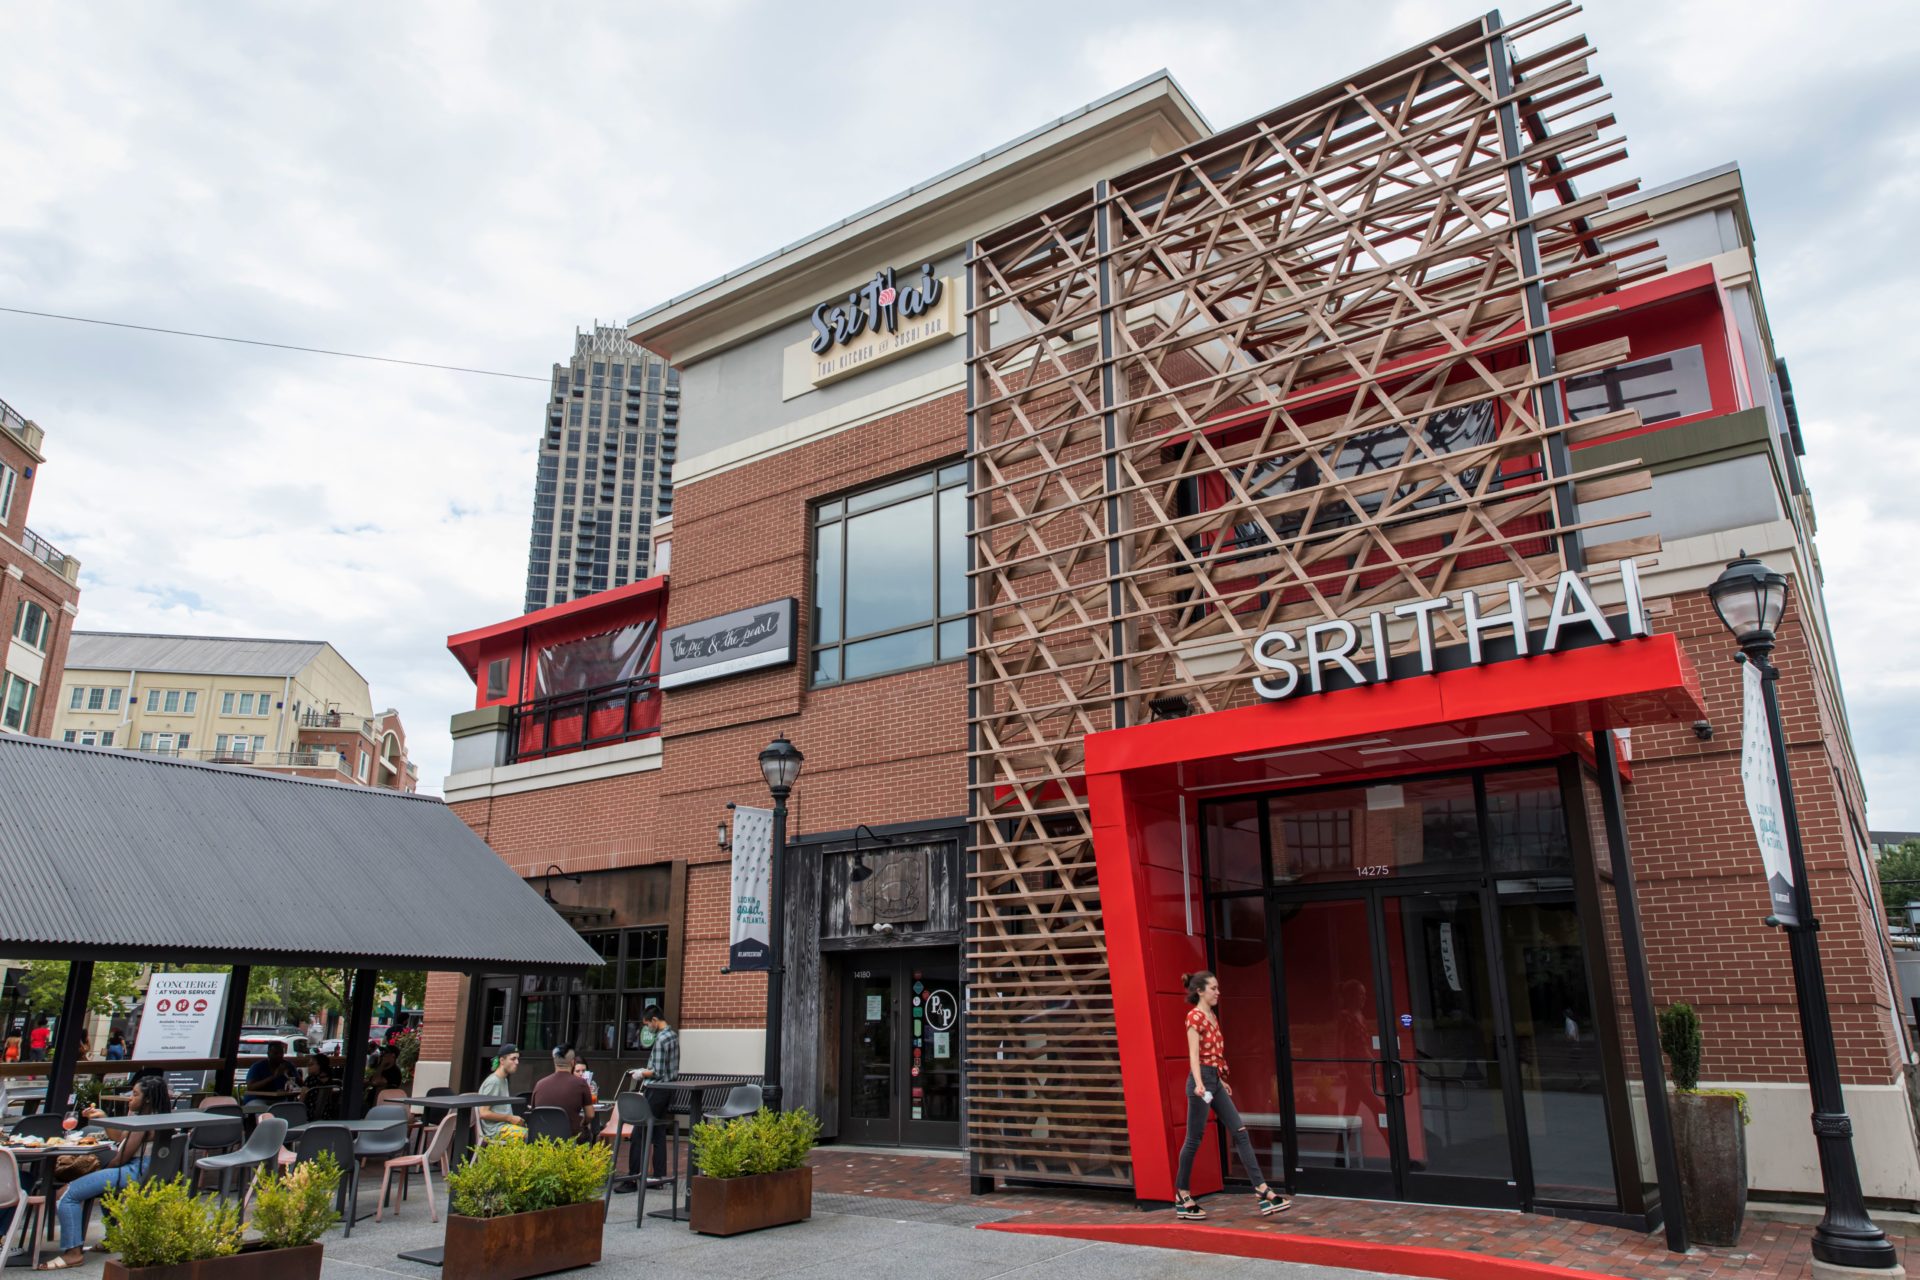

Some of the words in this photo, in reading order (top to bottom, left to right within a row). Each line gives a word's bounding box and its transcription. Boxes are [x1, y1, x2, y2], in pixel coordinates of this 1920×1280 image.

[839, 344, 873, 369] KITCHEN
[894, 328, 920, 348] SUSHI
[924, 318, 942, 337] BAR
[673, 641, 687, 657] the
[708, 636, 720, 654] &
[721, 630, 739, 648] the
[738, 616, 777, 648] pearl
[1252, 558, 1648, 700] SRITHAI
[1356, 865, 1389, 876] 14275
[156, 980, 218, 989] CONCIERGE
